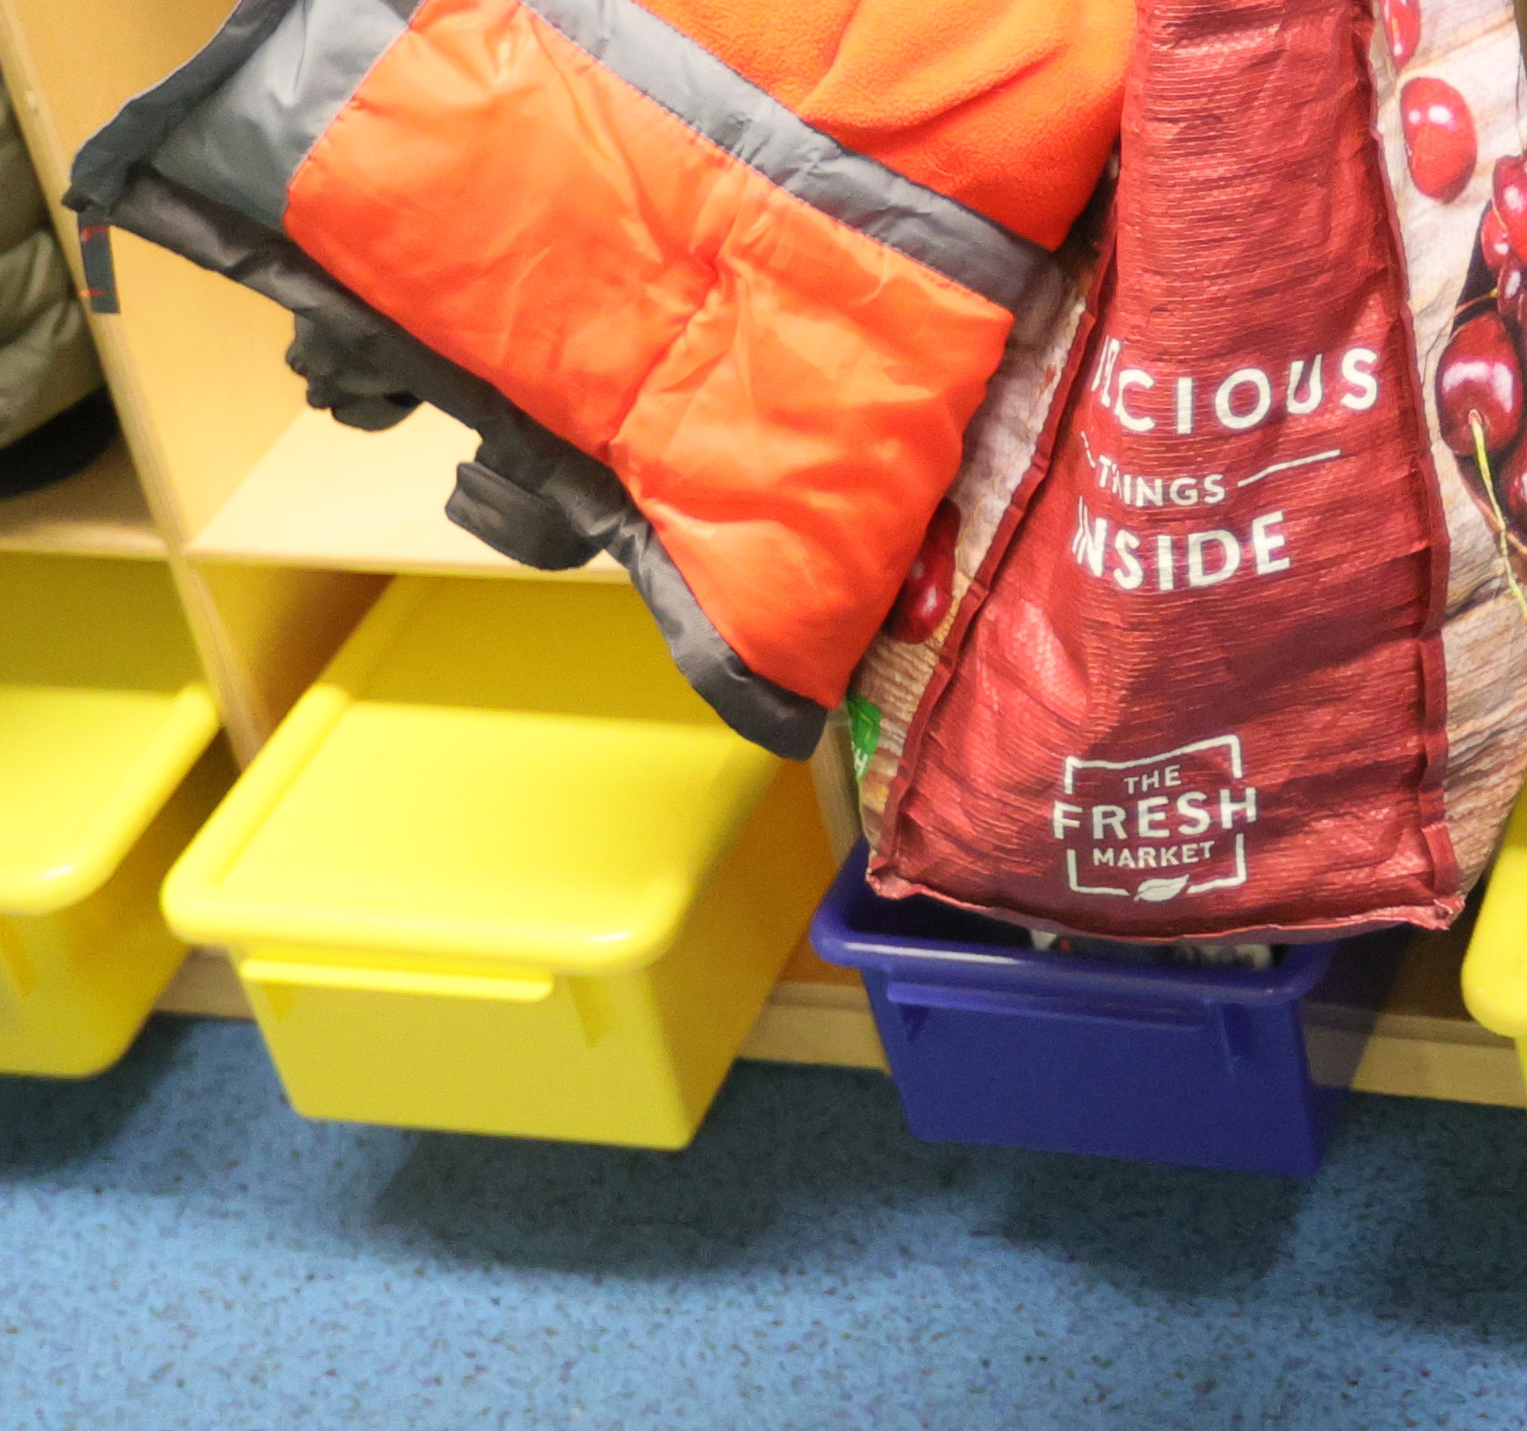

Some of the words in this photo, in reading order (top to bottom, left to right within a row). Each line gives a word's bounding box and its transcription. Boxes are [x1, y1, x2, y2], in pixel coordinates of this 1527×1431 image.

[1122, 764, 1183, 795] THE
[1052, 786, 1258, 840] FRESH
[1092, 840, 1216, 870] MARKET
